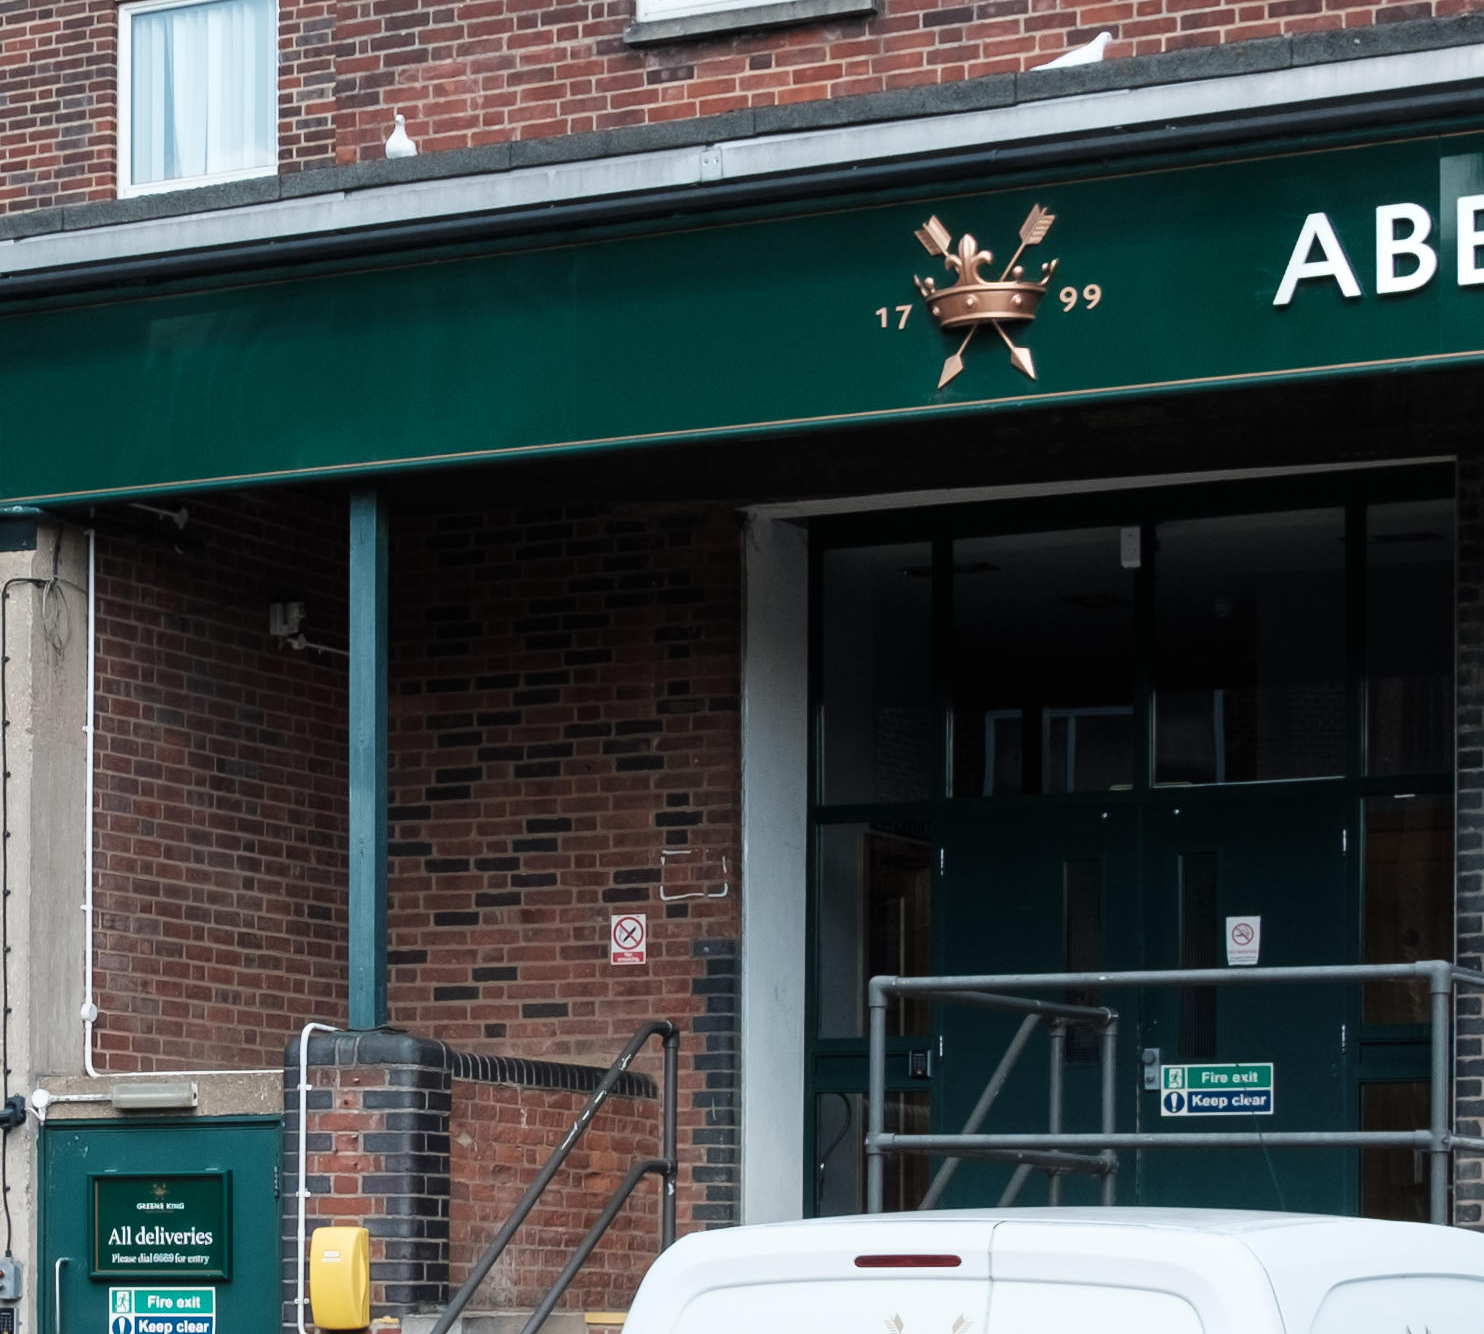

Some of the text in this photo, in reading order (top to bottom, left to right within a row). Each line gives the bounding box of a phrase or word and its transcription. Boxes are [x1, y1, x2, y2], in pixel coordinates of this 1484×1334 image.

[875, 283, 1103, 330] 17 99
[1201, 1070, 1258, 1083] Fire exit
[1192, 1094, 1267, 1109] Keep clear
[108, 1226, 213, 1245] All deliveries
[112, 1253, 137, 1264] Please
[138, 1253, 152, 1264] dial
[175, 1253, 186, 1264] for
[187, 1255, 210, 1265] entry
[147, 1295, 201, 1309] Fire exit
[176, 1320, 210, 1333] clear
